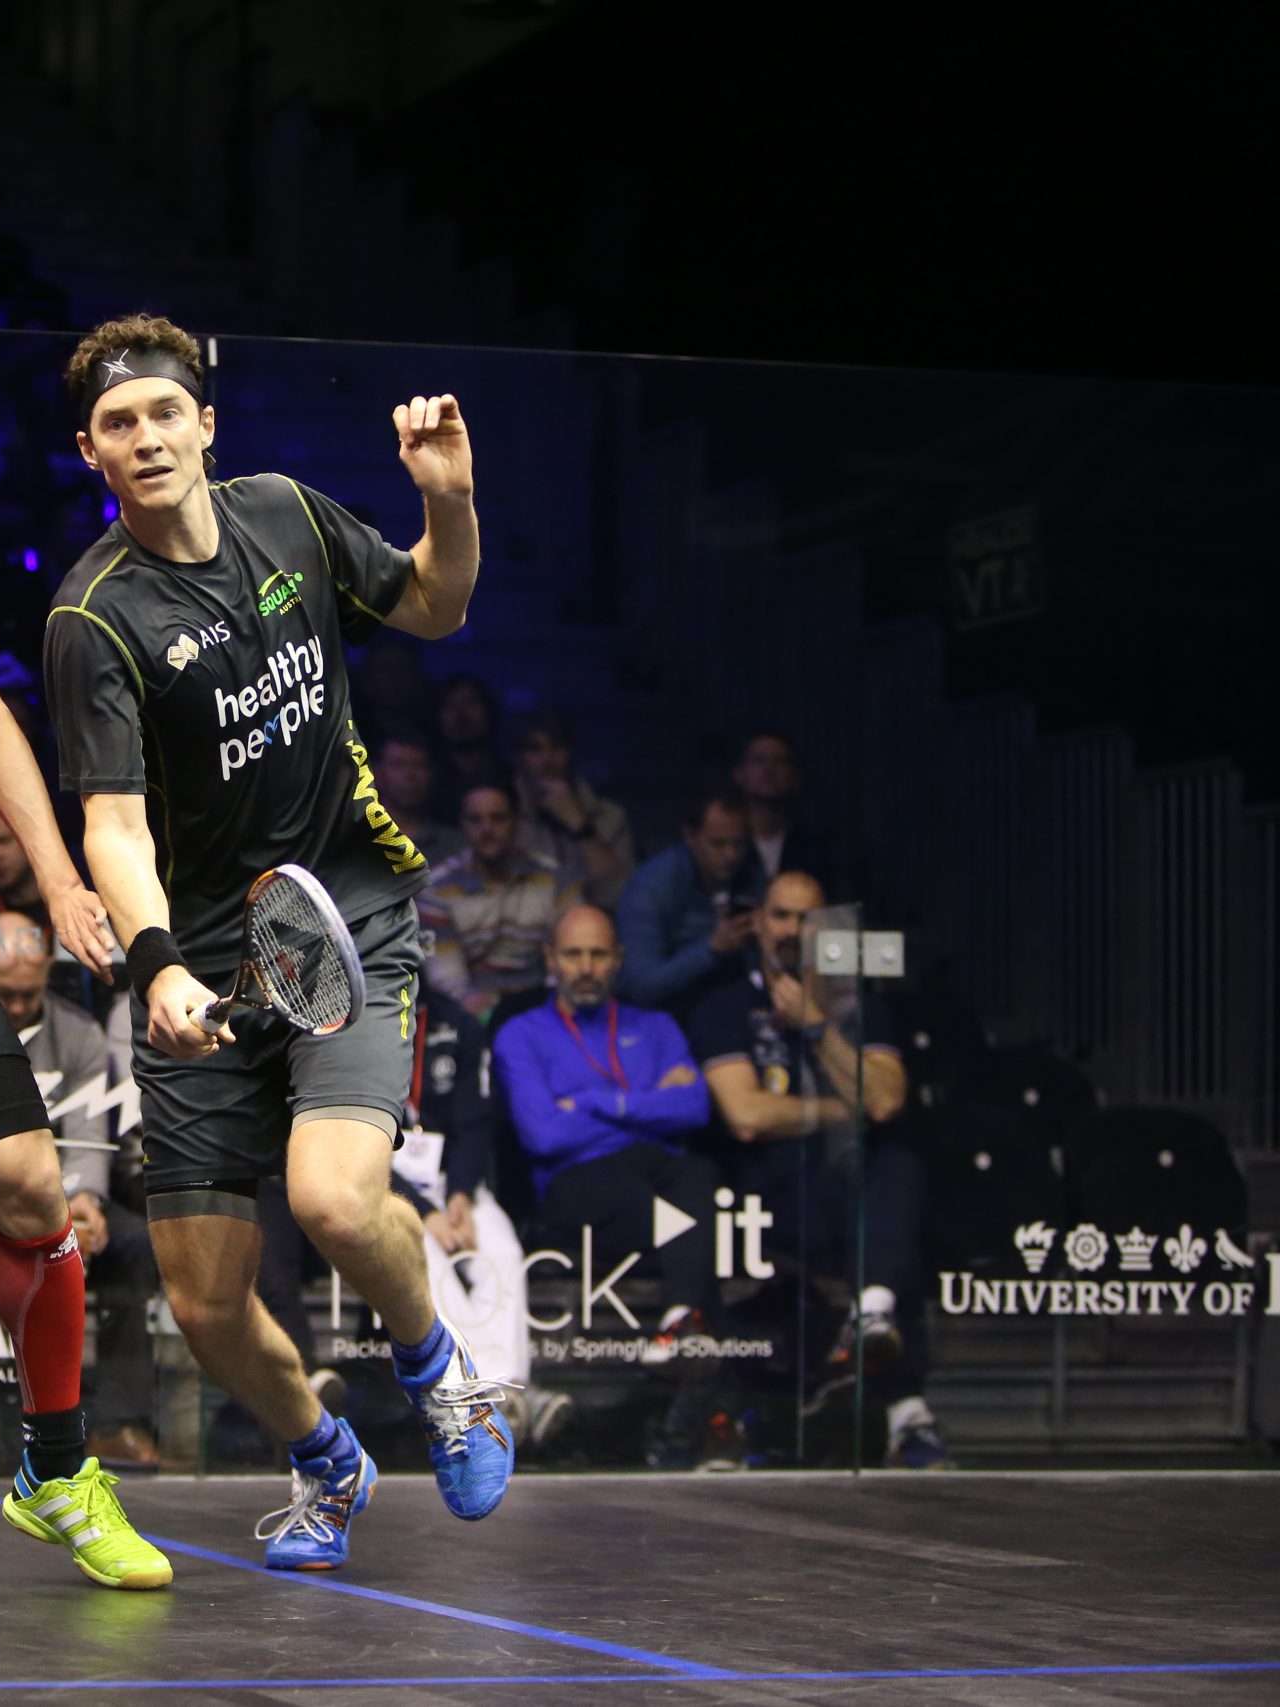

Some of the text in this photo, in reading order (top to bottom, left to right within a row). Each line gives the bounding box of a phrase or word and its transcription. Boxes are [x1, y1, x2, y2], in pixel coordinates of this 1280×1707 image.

[199, 621, 231, 649] AIS
[215, 635, 324, 727] healthy
[714, 1187, 776, 1279] it
[542, 1339, 568, 1362] by
[682, 1338, 773, 1358] Solutions
